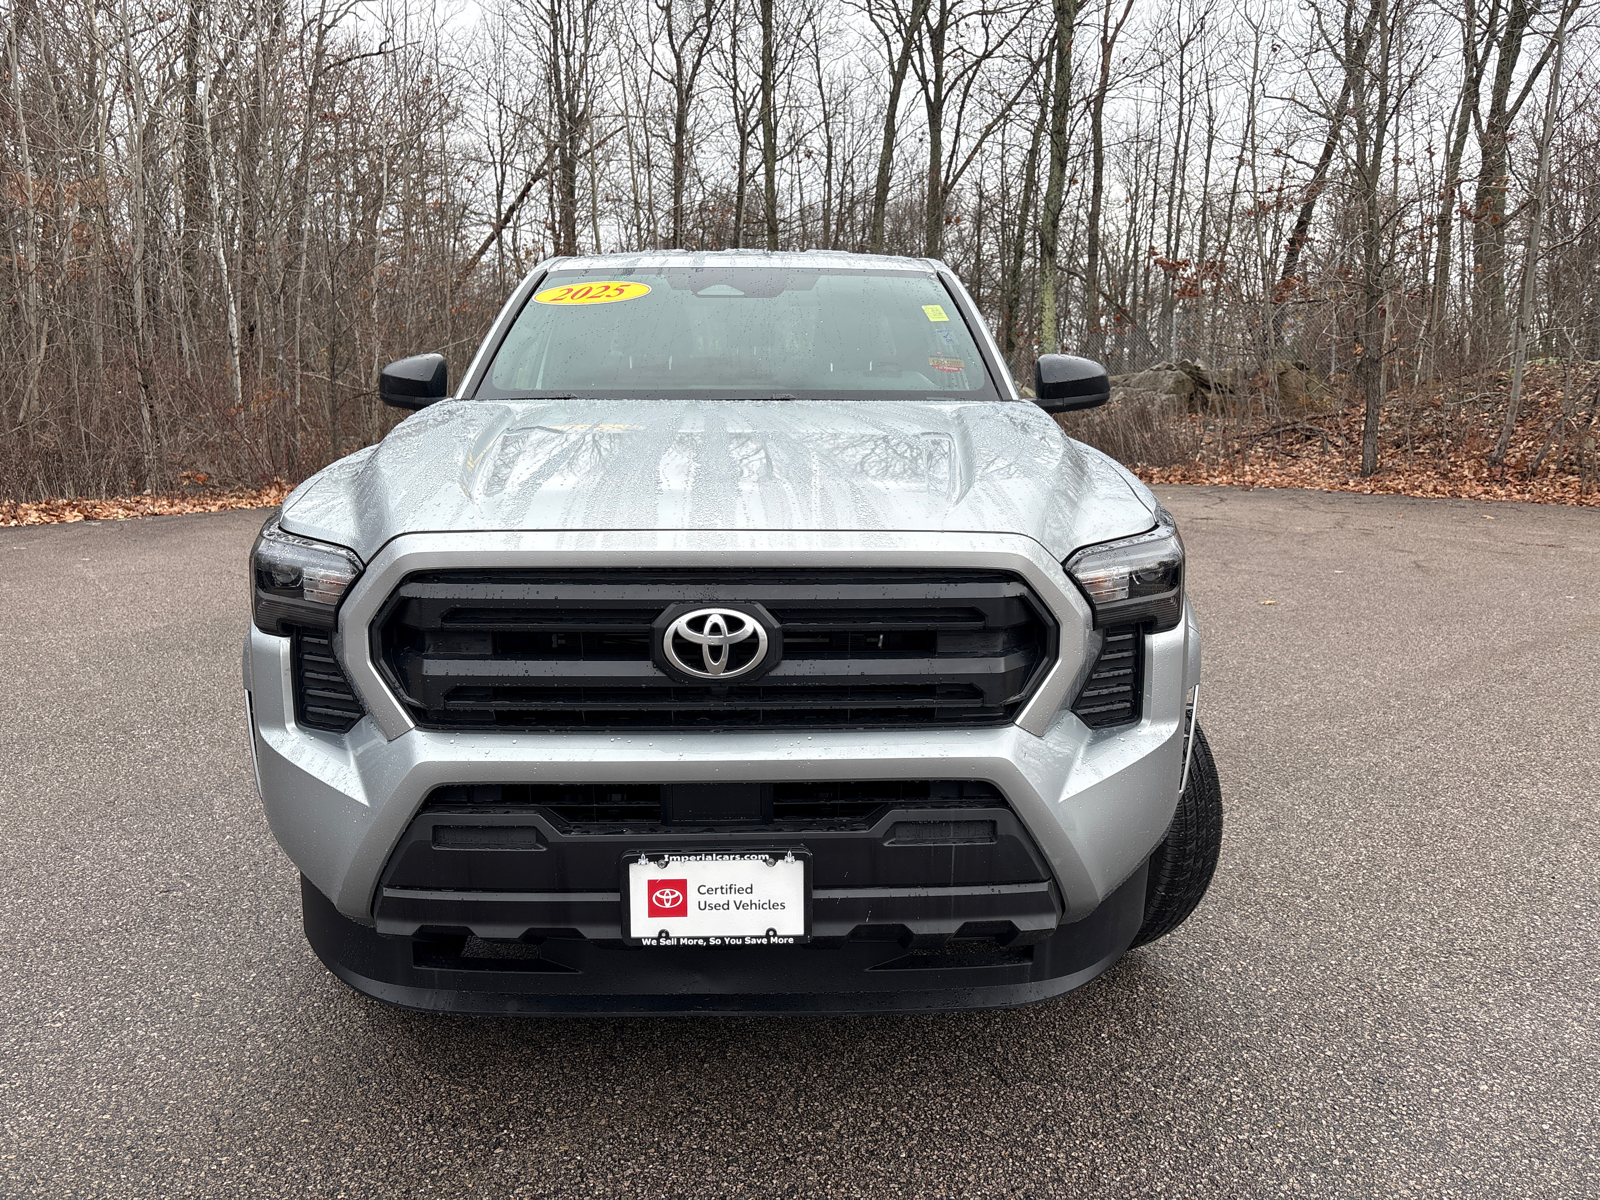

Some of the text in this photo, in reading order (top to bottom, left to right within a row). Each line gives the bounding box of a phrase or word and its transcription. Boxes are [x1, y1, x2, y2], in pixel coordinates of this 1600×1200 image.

[549, 284, 631, 301] 2025
[664, 853, 769, 862] Imperialcars.com
[697, 883, 753, 895] Certified
[697, 899, 786, 911] Used Vehicles
[641, 936, 794, 946] We Sell More, So You Save More
